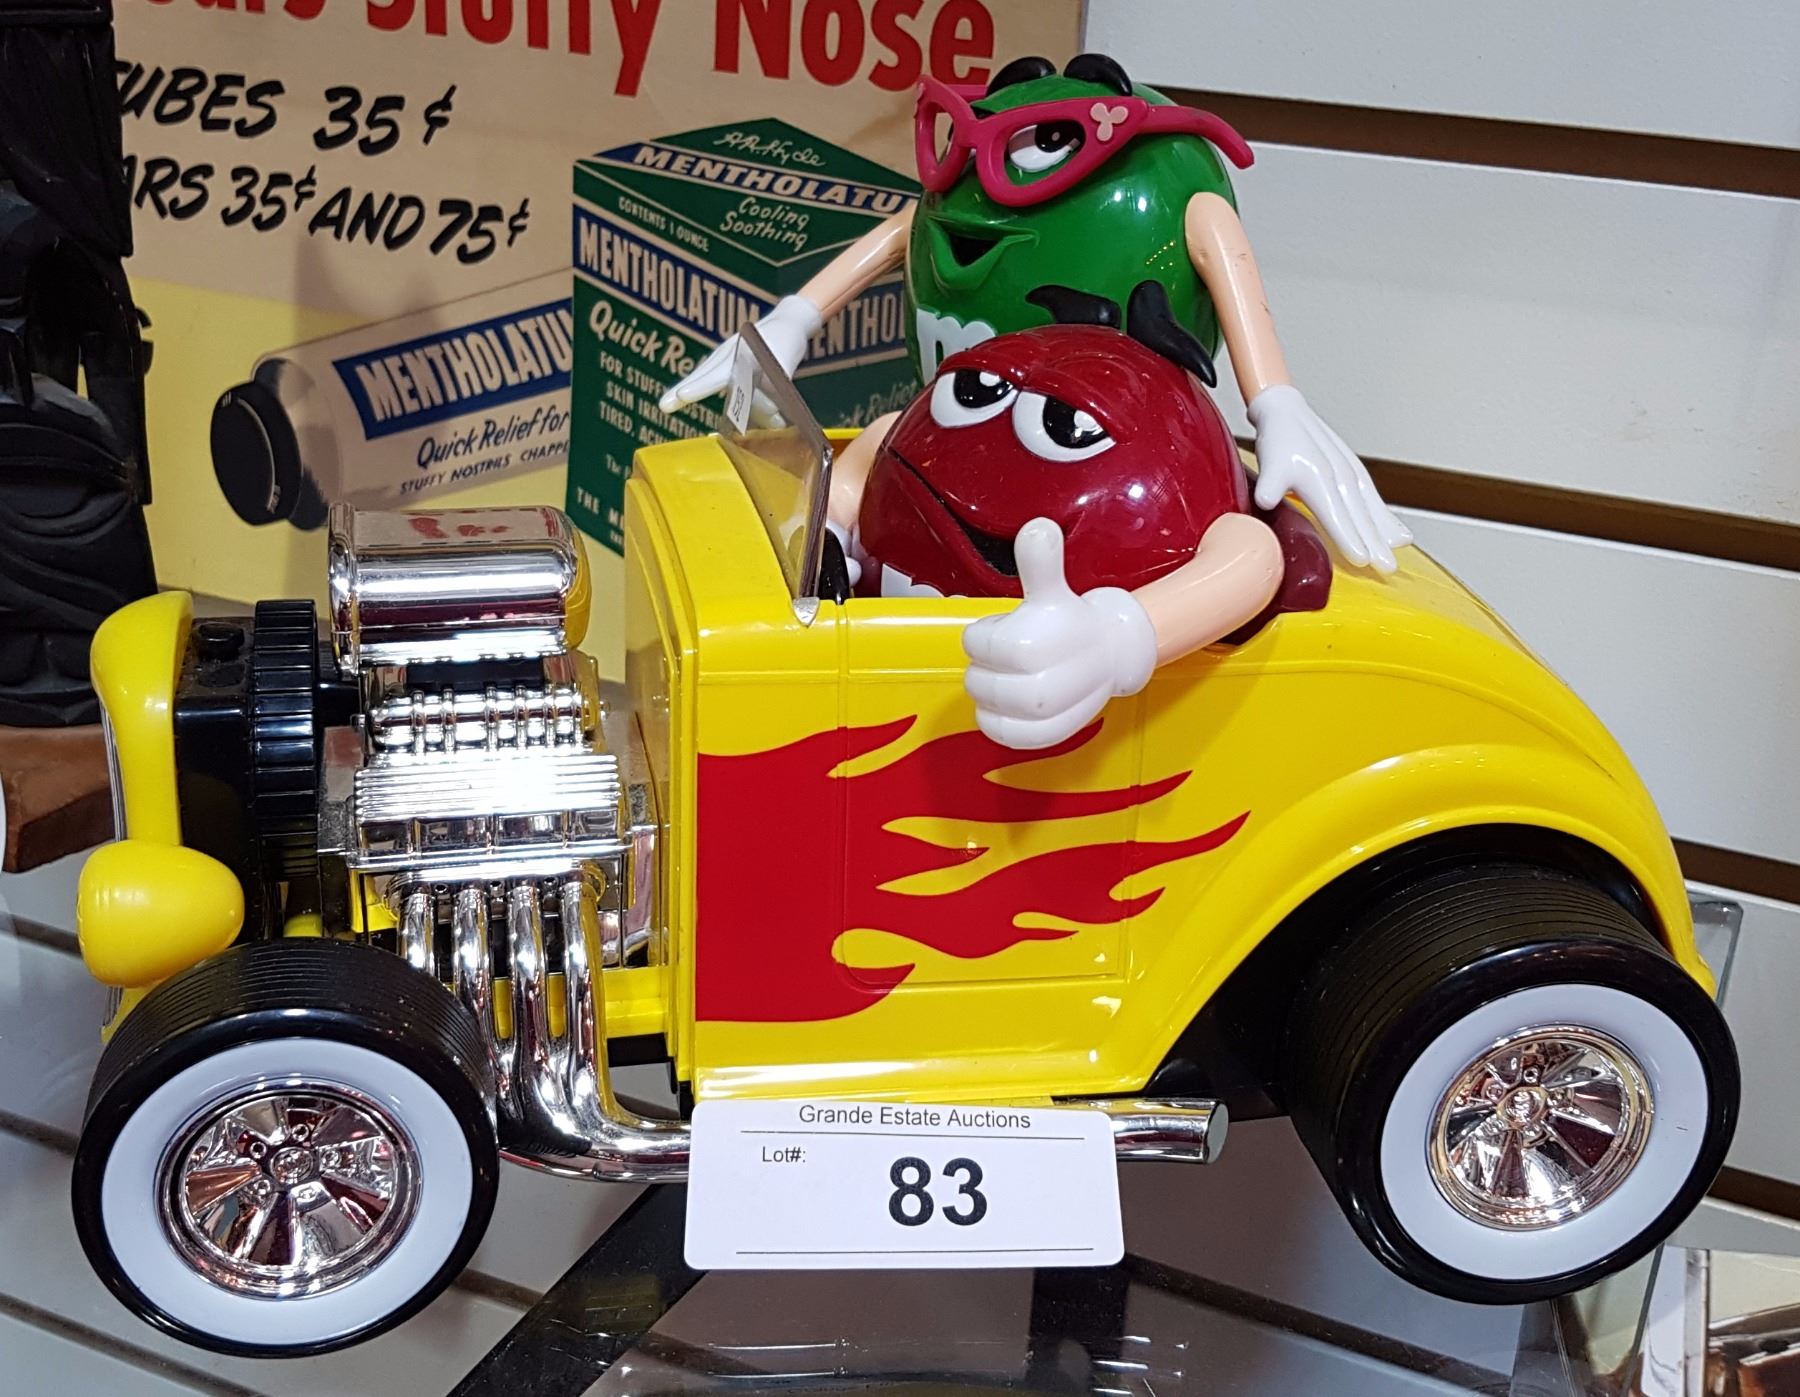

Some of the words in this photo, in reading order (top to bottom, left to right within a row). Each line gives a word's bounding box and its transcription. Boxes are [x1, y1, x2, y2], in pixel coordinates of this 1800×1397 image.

[714, 0, 994, 92] Nose
[115, 60, 284, 138] UBES
[313, 86, 405, 156] 35
[634, 146, 902, 213] MENTHOLATU
[308, 187, 425, 250] AND
[618, 196, 666, 230] CONTENTS
[676, 225, 709, 253] OUNCE
[720, 211, 808, 252] Soothing
[739, 197, 809, 231] Cooling
[580, 216, 760, 338] MENTHOLATUM
[589, 300, 663, 362] Quick
[660, 335, 707, 378] Re
[804, 289, 905, 361] ENTHO
[600, 351, 623, 379] FOR
[418, 427, 478, 470] Quick
[479, 406, 543, 450] Relief
[540, 404, 569, 435] for
[606, 381, 634, 411] SKIN
[638, 398, 705, 439] IRRITATIO
[400, 473, 446, 495] STUFFY
[450, 454, 512, 483] NOSTRILS
[577, 486, 599, 515] THE
[799, 1104, 873, 1125] Grande
[880, 1106, 941, 1127] Estate
[948, 1107, 1031, 1129] Auctions
[762, 1146, 806, 1163] Lot#:
[888, 1156, 988, 1227] 83
